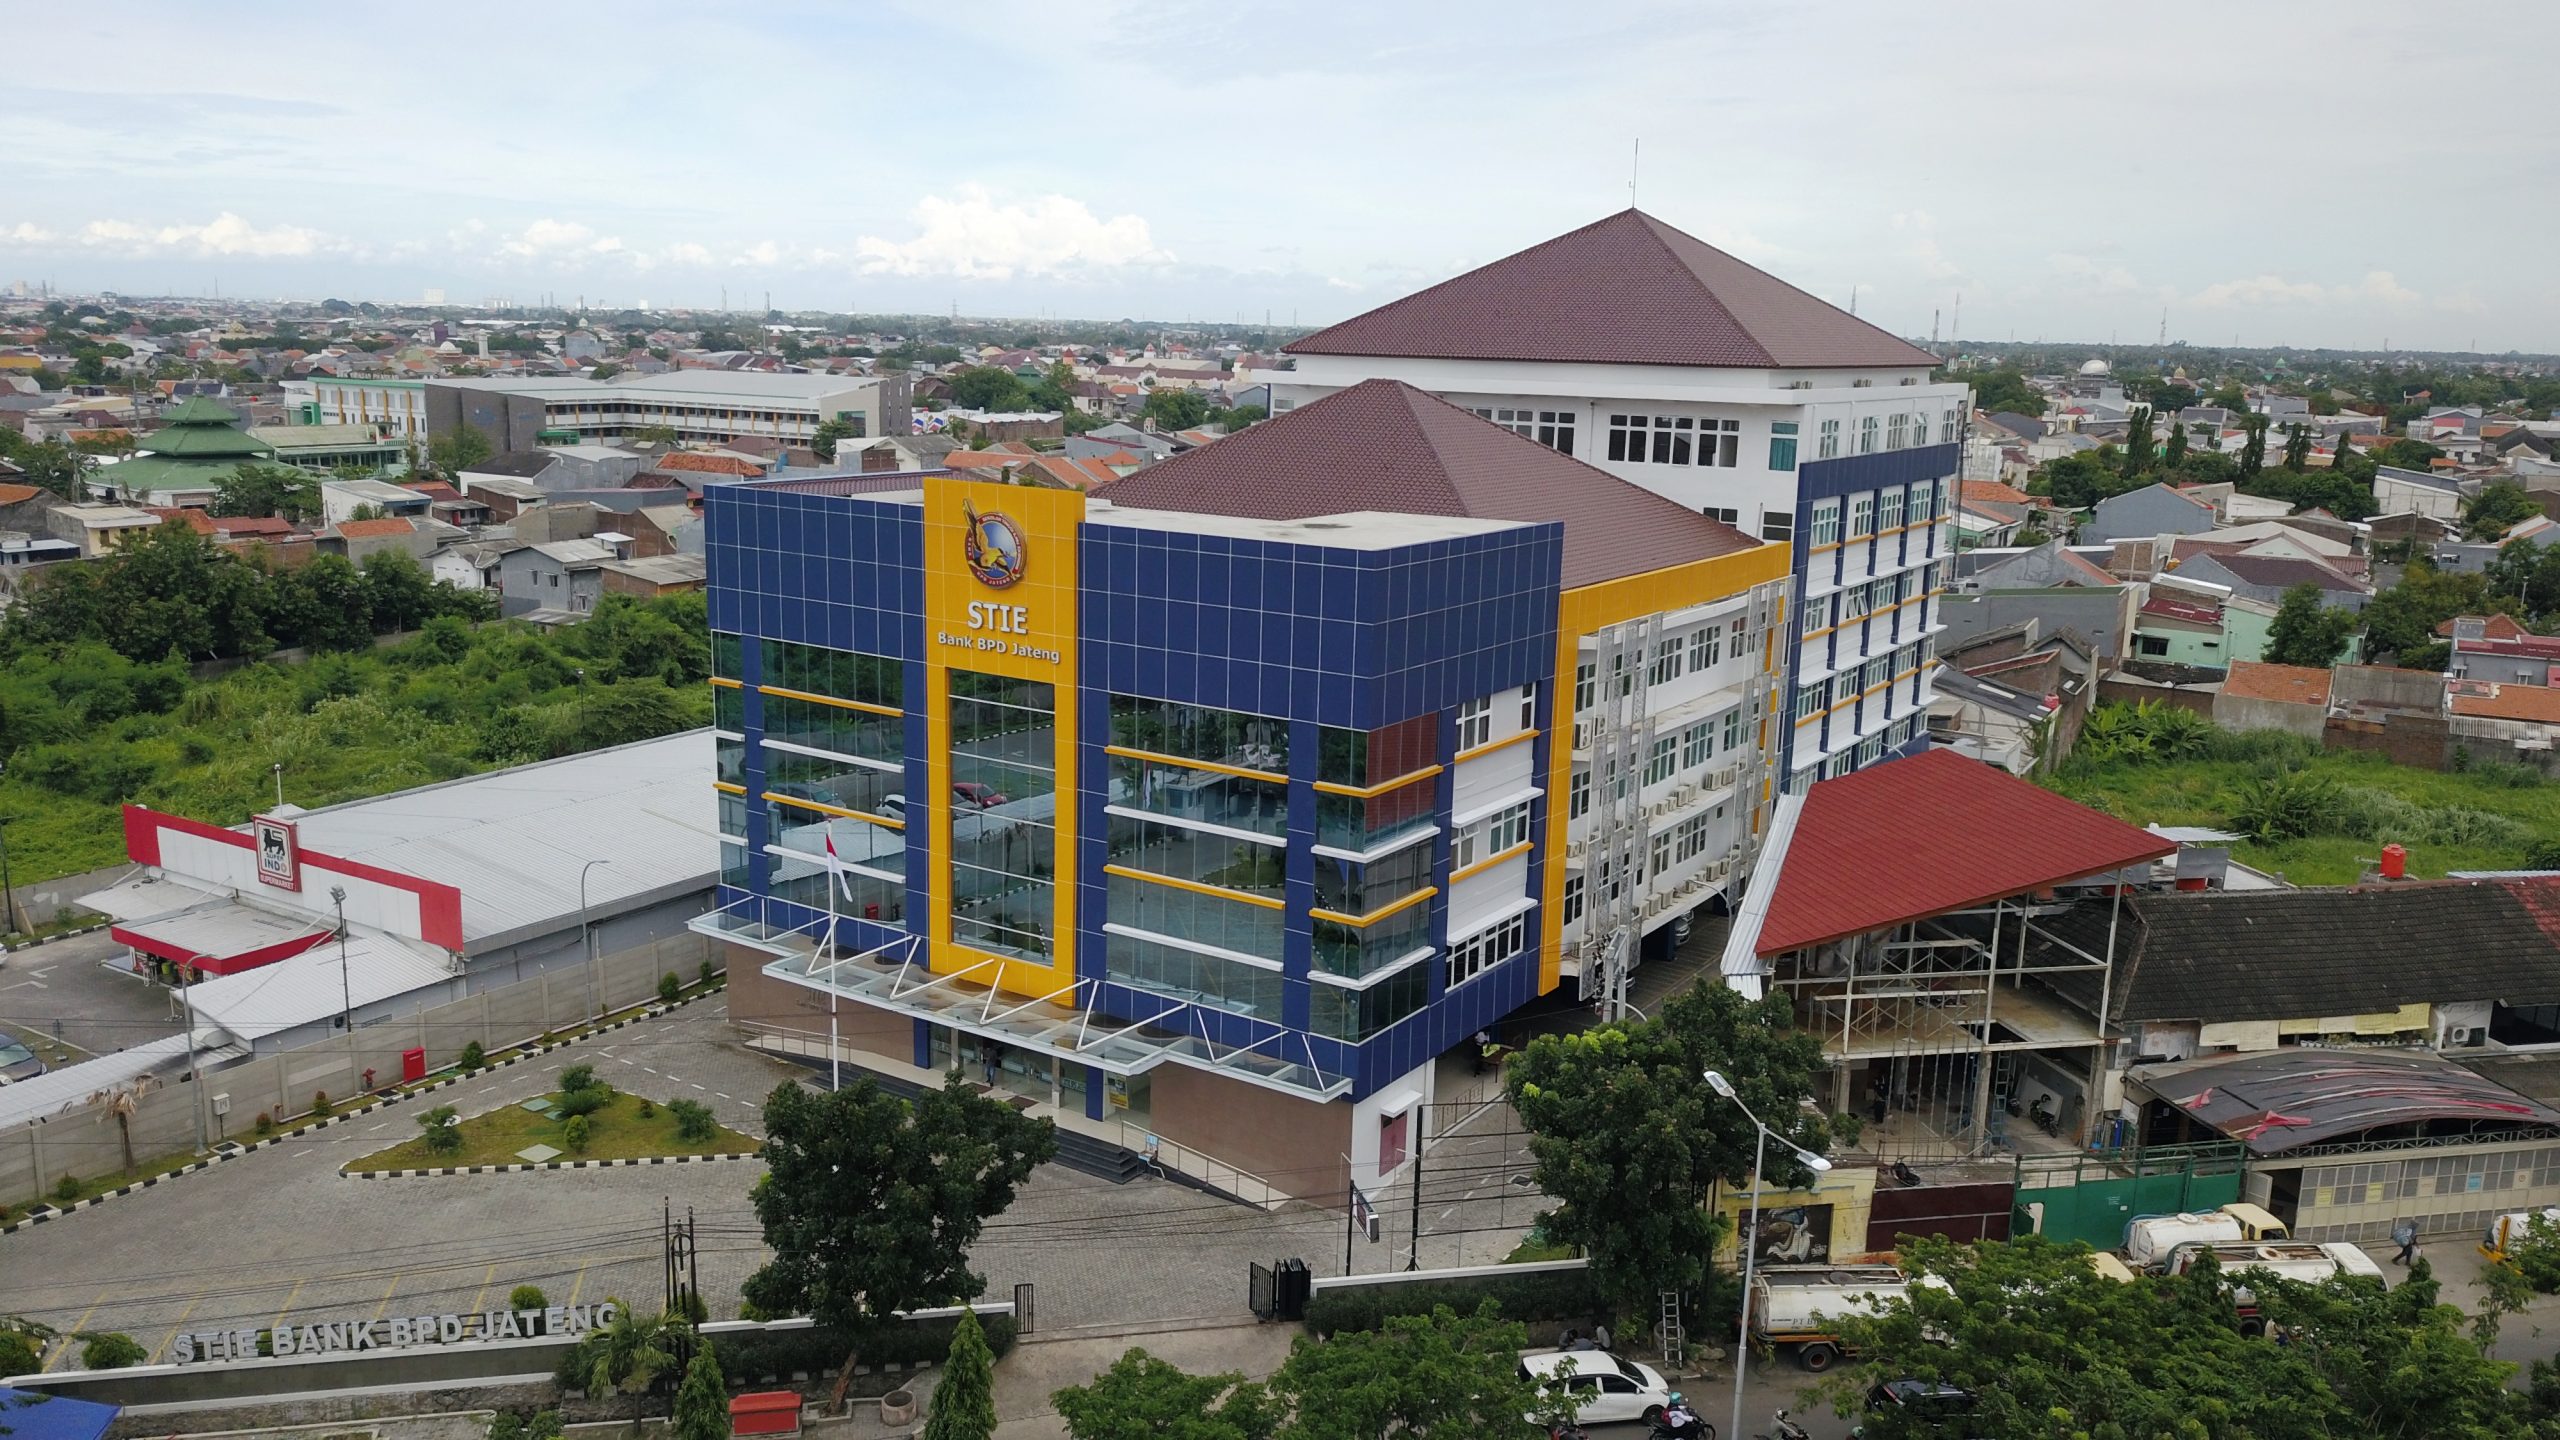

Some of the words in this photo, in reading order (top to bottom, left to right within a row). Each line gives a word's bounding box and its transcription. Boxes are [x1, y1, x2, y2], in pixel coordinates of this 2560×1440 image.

[967, 601, 1028, 634] STIE
[938, 631, 973, 648] Bank
[977, 638, 1007, 653] BPD
[1011, 643, 1060, 664] Jateng
[264, 858, 287, 873] INDO
[173, 1330, 259, 1363] STIE
[271, 1320, 378, 1356] BANK
[389, 1314, 463, 1346] BPD
